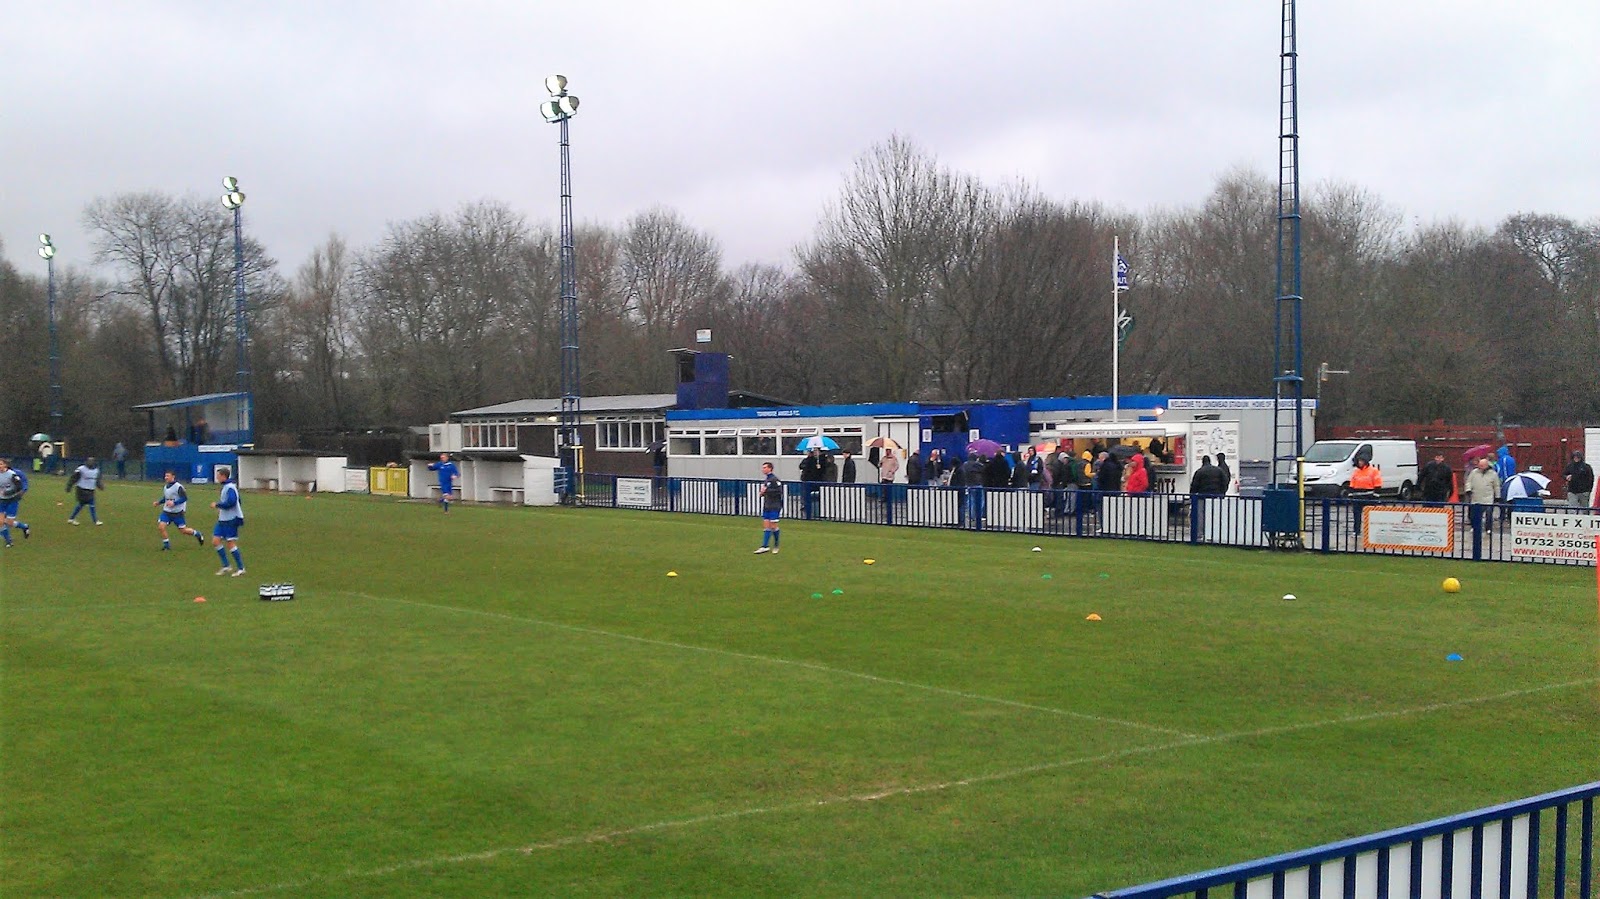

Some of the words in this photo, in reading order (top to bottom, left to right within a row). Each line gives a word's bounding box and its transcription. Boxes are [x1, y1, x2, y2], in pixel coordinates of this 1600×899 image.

[1516, 516, 1557, 527] NEV'LL
[1590, 519, 1600, 529] IT
[1517, 530, 1545, 538] Garage
[1515, 537, 1554, 546] 01732
